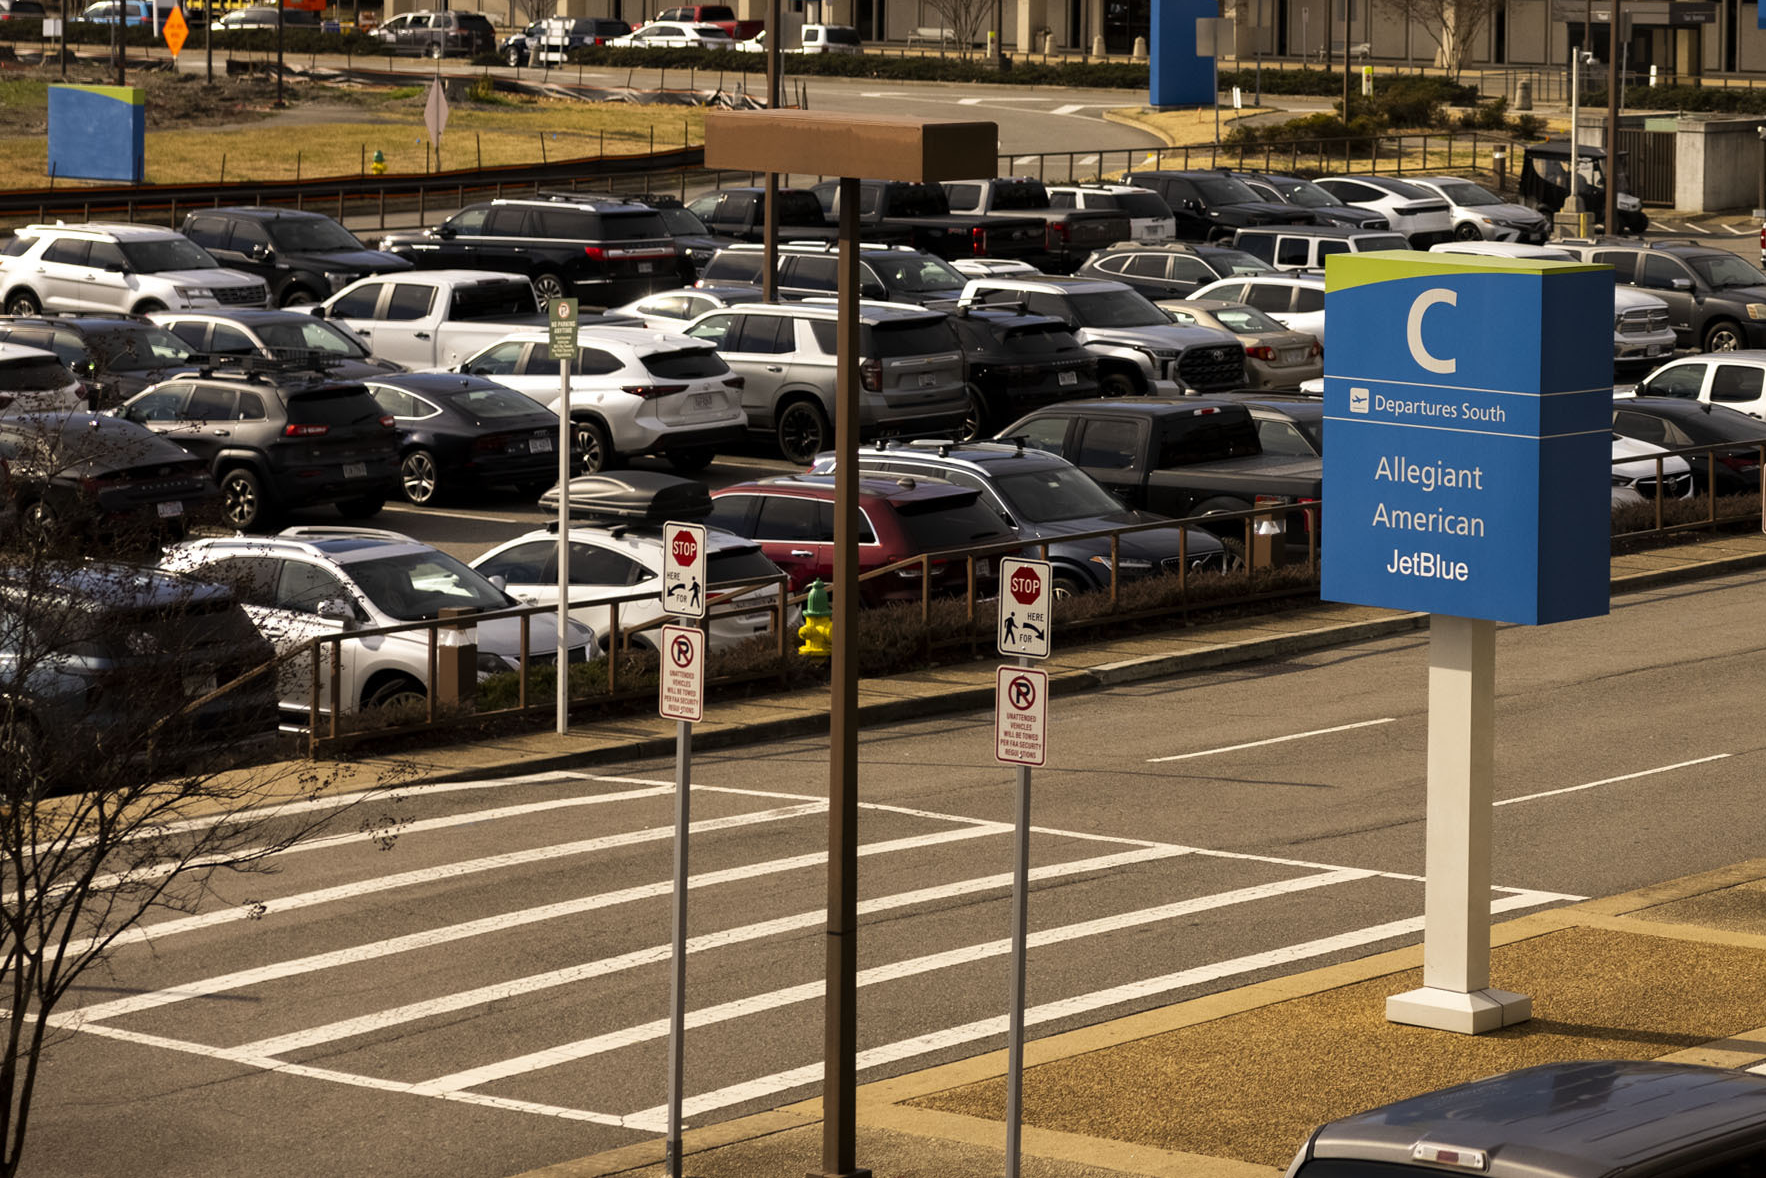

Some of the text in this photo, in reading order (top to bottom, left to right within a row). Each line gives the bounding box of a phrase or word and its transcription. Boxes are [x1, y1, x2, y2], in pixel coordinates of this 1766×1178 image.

[1406, 288, 1458, 374] C
[1375, 394, 1507, 423] Departures South
[1375, 456, 1484, 492] Allegiant
[1372, 502, 1486, 537] American
[673, 540, 697, 557] STOP
[1386, 548, 1470, 582] JetBlue
[666, 571, 681, 581] HERE
[1011, 577, 1040, 595] STOP
[676, 593, 688, 603] FOR
[1027, 612, 1044, 622] HERE
[1019, 633, 1032, 643] FOR
[1006, 712, 1037, 722] UNATTENDED
[1010, 722, 1032, 731] VEHICLES
[1003, 730, 1015, 738] WILL
[1022, 732, 1039, 741] TOWED
[1000, 738, 1042, 750] PER FAA SECURITY
